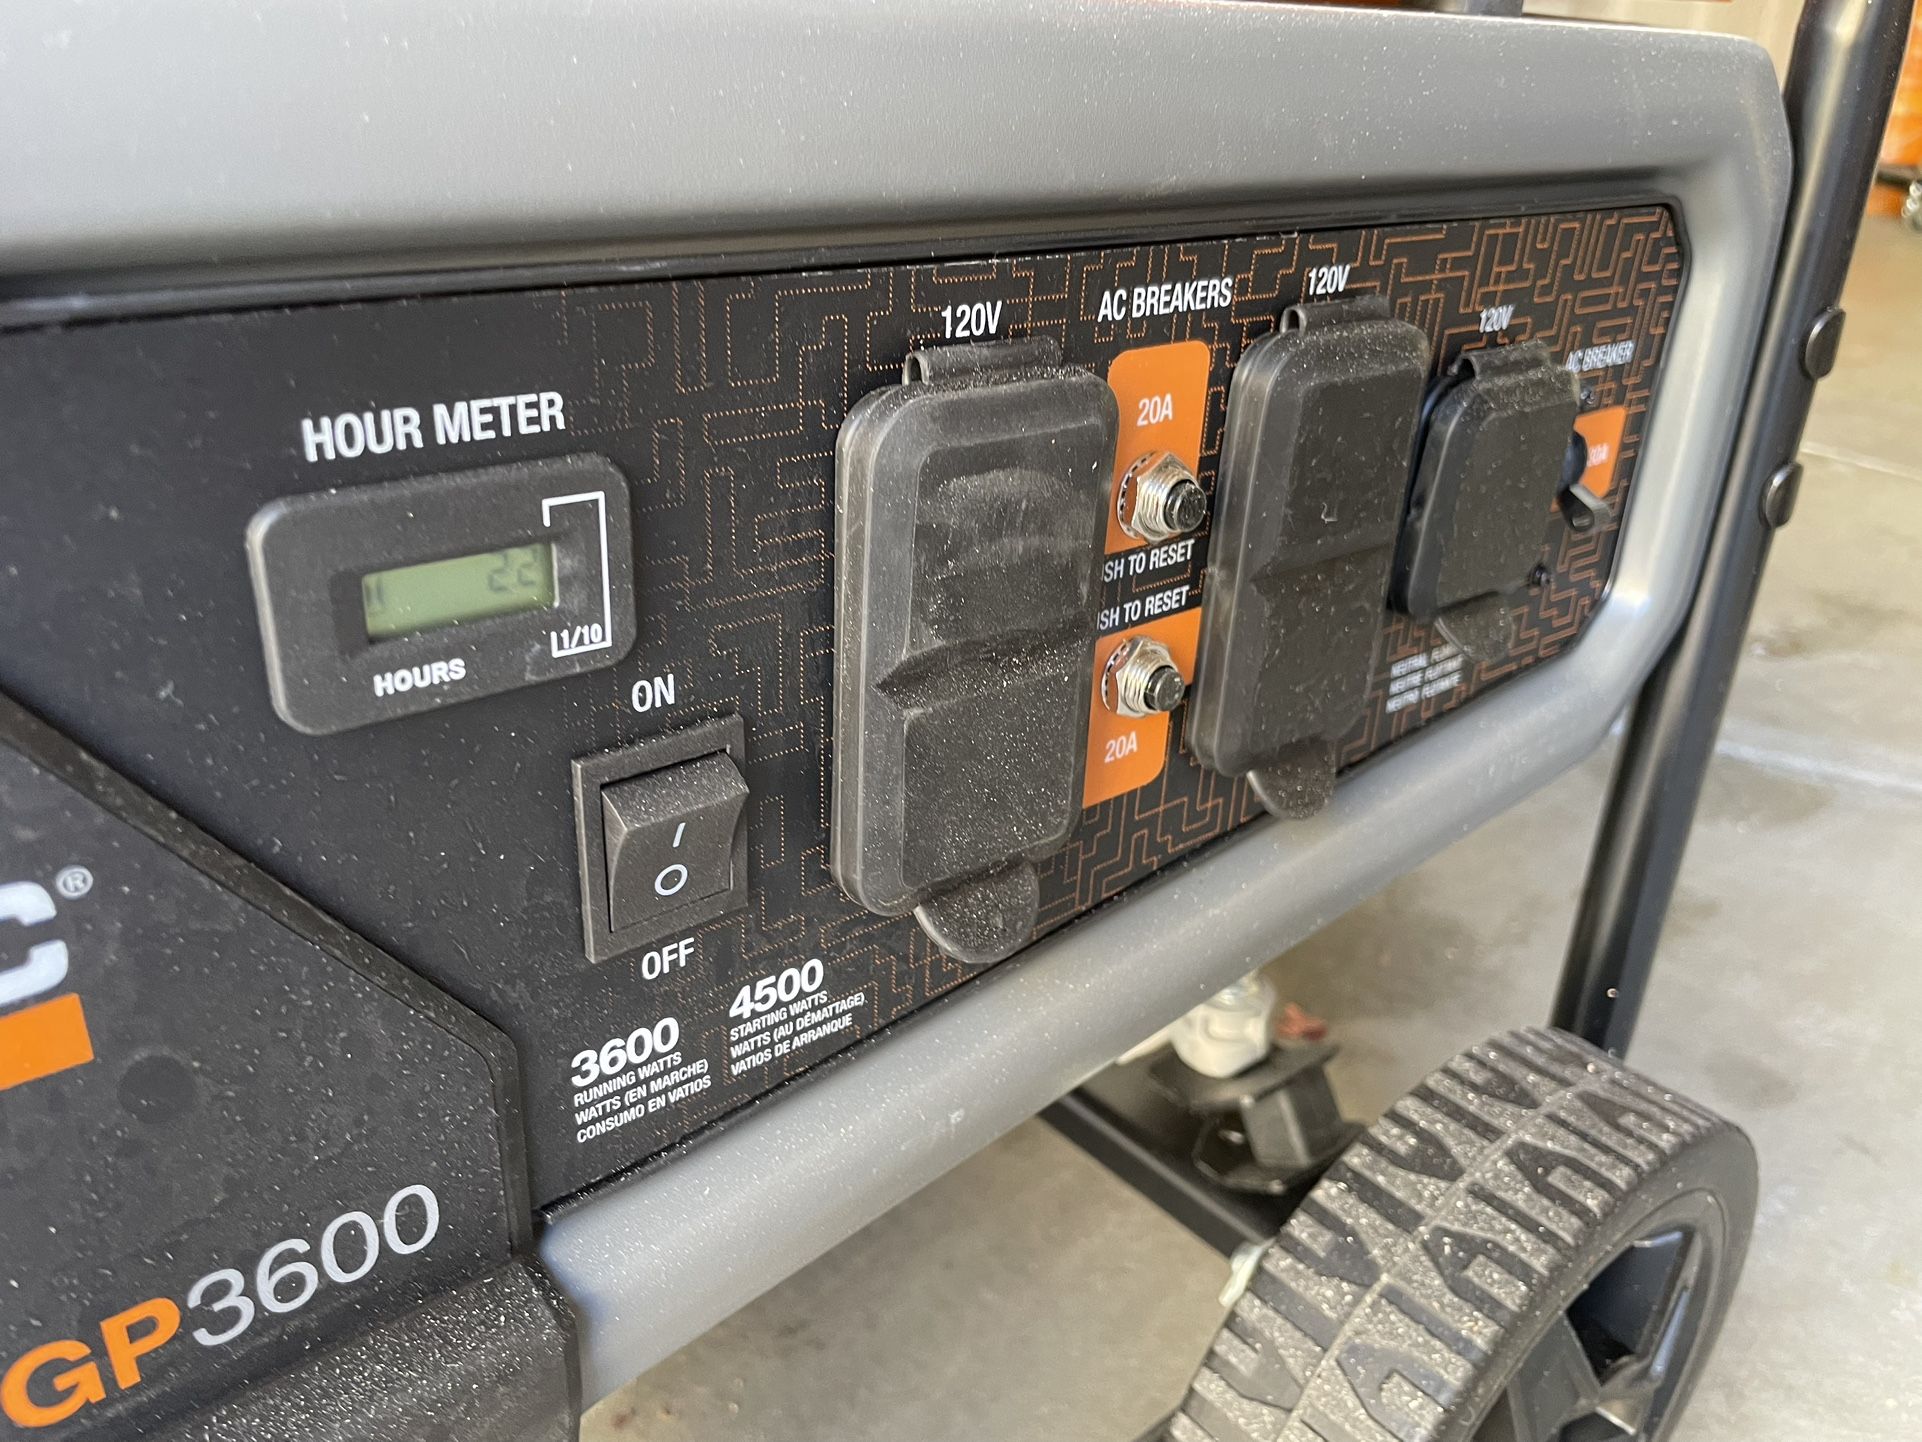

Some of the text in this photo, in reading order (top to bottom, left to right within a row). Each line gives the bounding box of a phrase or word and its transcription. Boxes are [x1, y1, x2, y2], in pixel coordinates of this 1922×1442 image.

[1098, 277, 1232, 322] AC BREAKERS
[1309, 264, 1349, 295] 120V
[941, 301, 1002, 338] 120V
[1479, 304, 1515, 333] 120V
[1565, 339, 1635, 373] AC BREAKER
[302, 392, 566, 462] HOUR METER
[1137, 393, 1173, 426] 20A
[1101, 539, 1195, 582] SH TO RESET
[1097, 585, 1190, 631] SH TO RESET
[560, 623, 603, 649] 1/10
[373, 659, 466, 696] HOURS
[631, 674, 675, 712] ON
[1104, 731, 1138, 763] 20A
[641, 938, 695, 980] OFF
[729, 958, 824, 1019] 4500
[730, 990, 828, 1041] STARTING WATTS
[730, 992, 865, 1058] WATTS (AU DÉMATTAGE)
[571, 1017, 680, 1087] 3600
[731, 1013, 853, 1076] VATIOS DE ARRANQUE
[574, 1052, 682, 1107] RUNNING WATTS
[575, 1059, 709, 1125] WATTS (EN MARCHE)
[577, 1075, 711, 1143] CONSUMO EN VATIOS
[0, 1185, 439, 1428] GP3600
